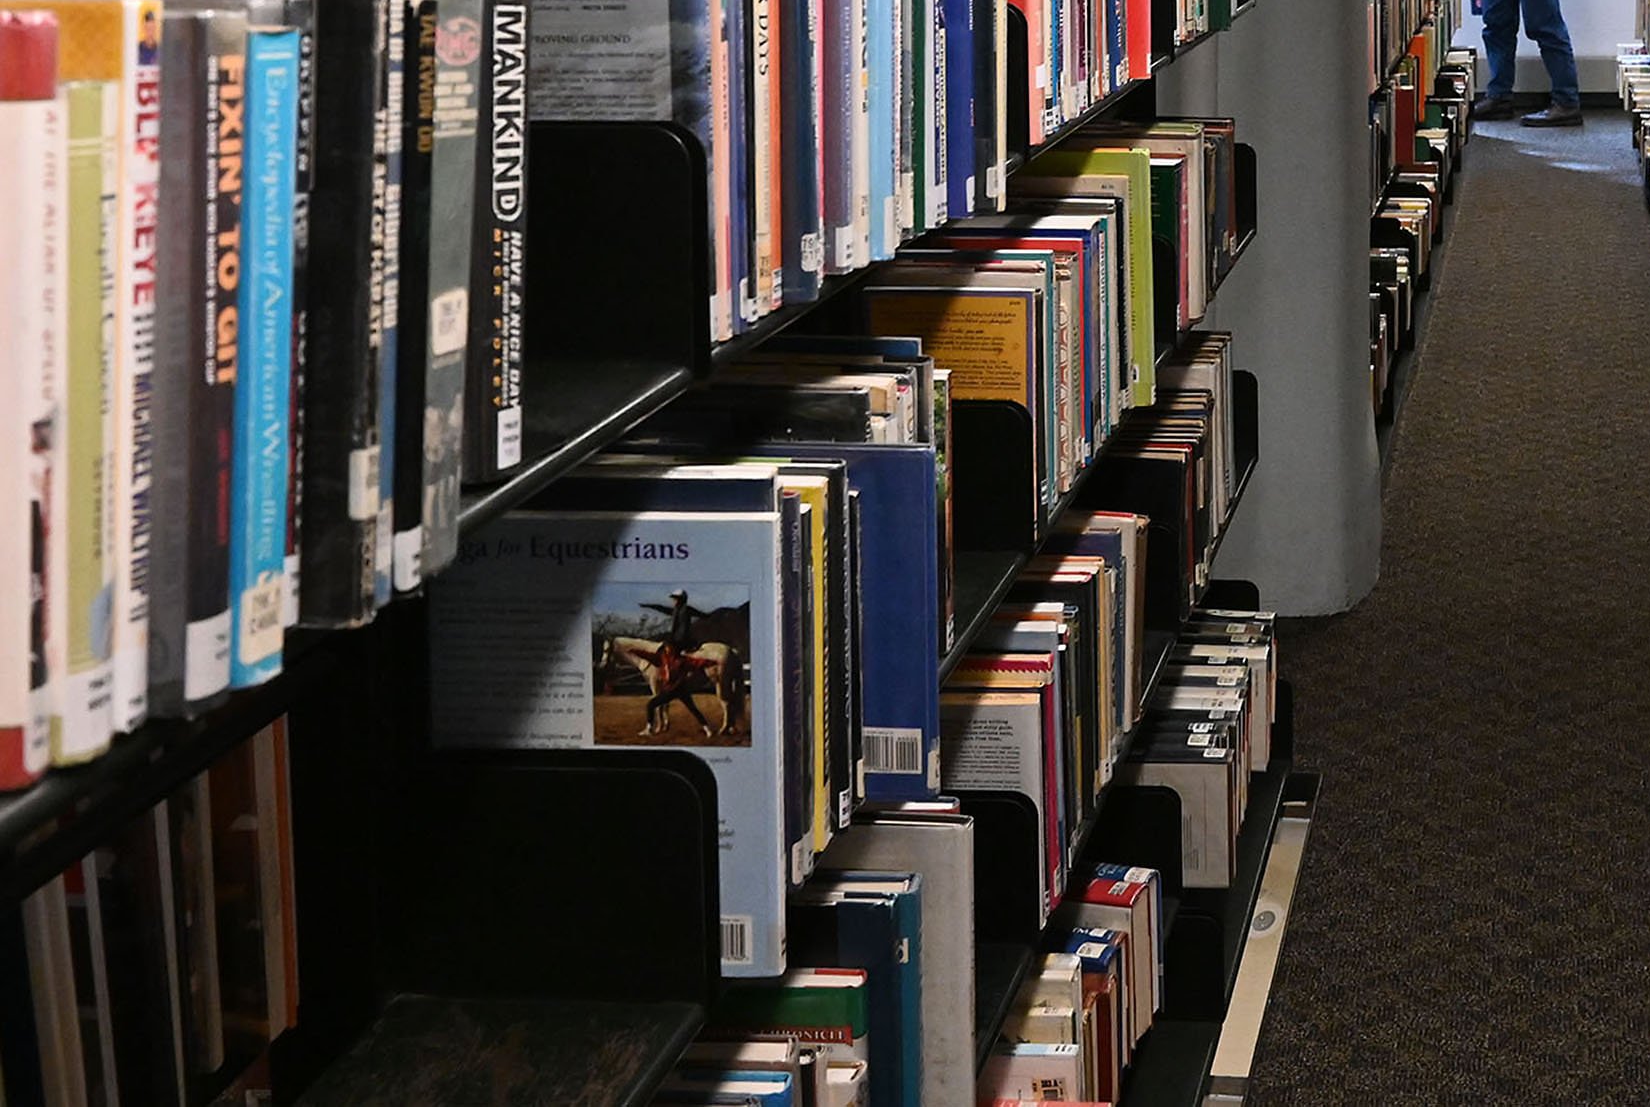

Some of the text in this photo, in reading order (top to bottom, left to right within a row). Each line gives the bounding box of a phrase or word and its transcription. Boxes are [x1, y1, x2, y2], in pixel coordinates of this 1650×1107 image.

[418, 13, 437, 47] TAE
[580, 32, 632, 45] GROUND
[757, 13, 770, 77] DAYS
[417, 55, 437, 120] KWON
[492, 5, 527, 224] MANKIND
[261, 66, 288, 246] Encyclopedia
[215, 54, 246, 390] FIXIN' TO GIT
[264, 250, 285, 278] of
[261, 280, 284, 420] American
[508, 231, 523, 409] HAVE A NICE DAY
[529, 534, 691, 564] Equestrians
